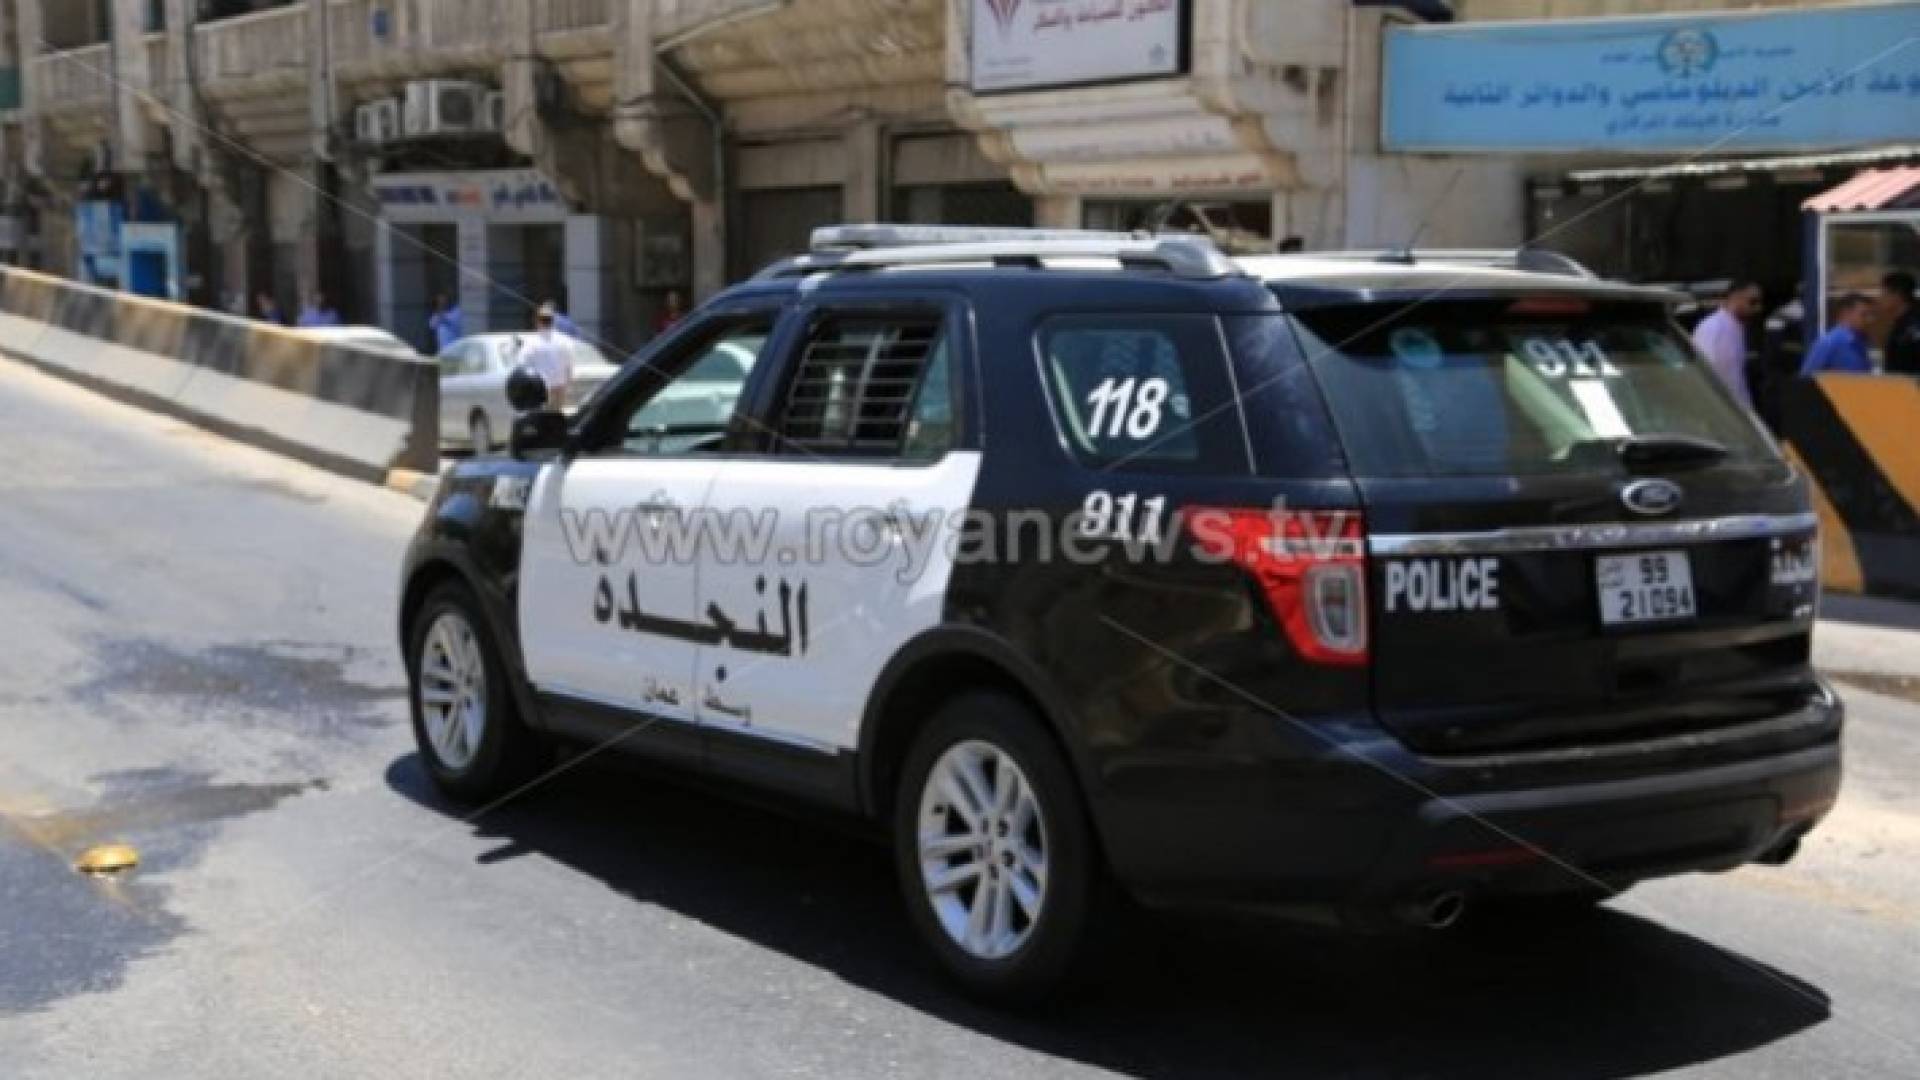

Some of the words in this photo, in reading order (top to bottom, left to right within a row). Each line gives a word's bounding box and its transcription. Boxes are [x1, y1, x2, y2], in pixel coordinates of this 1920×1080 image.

[1087, 376, 1168, 439] 118
[1081, 489, 1164, 545] 911
[592, 545, 810, 683] النجدة
[1384, 558, 1500, 613] POLICE
